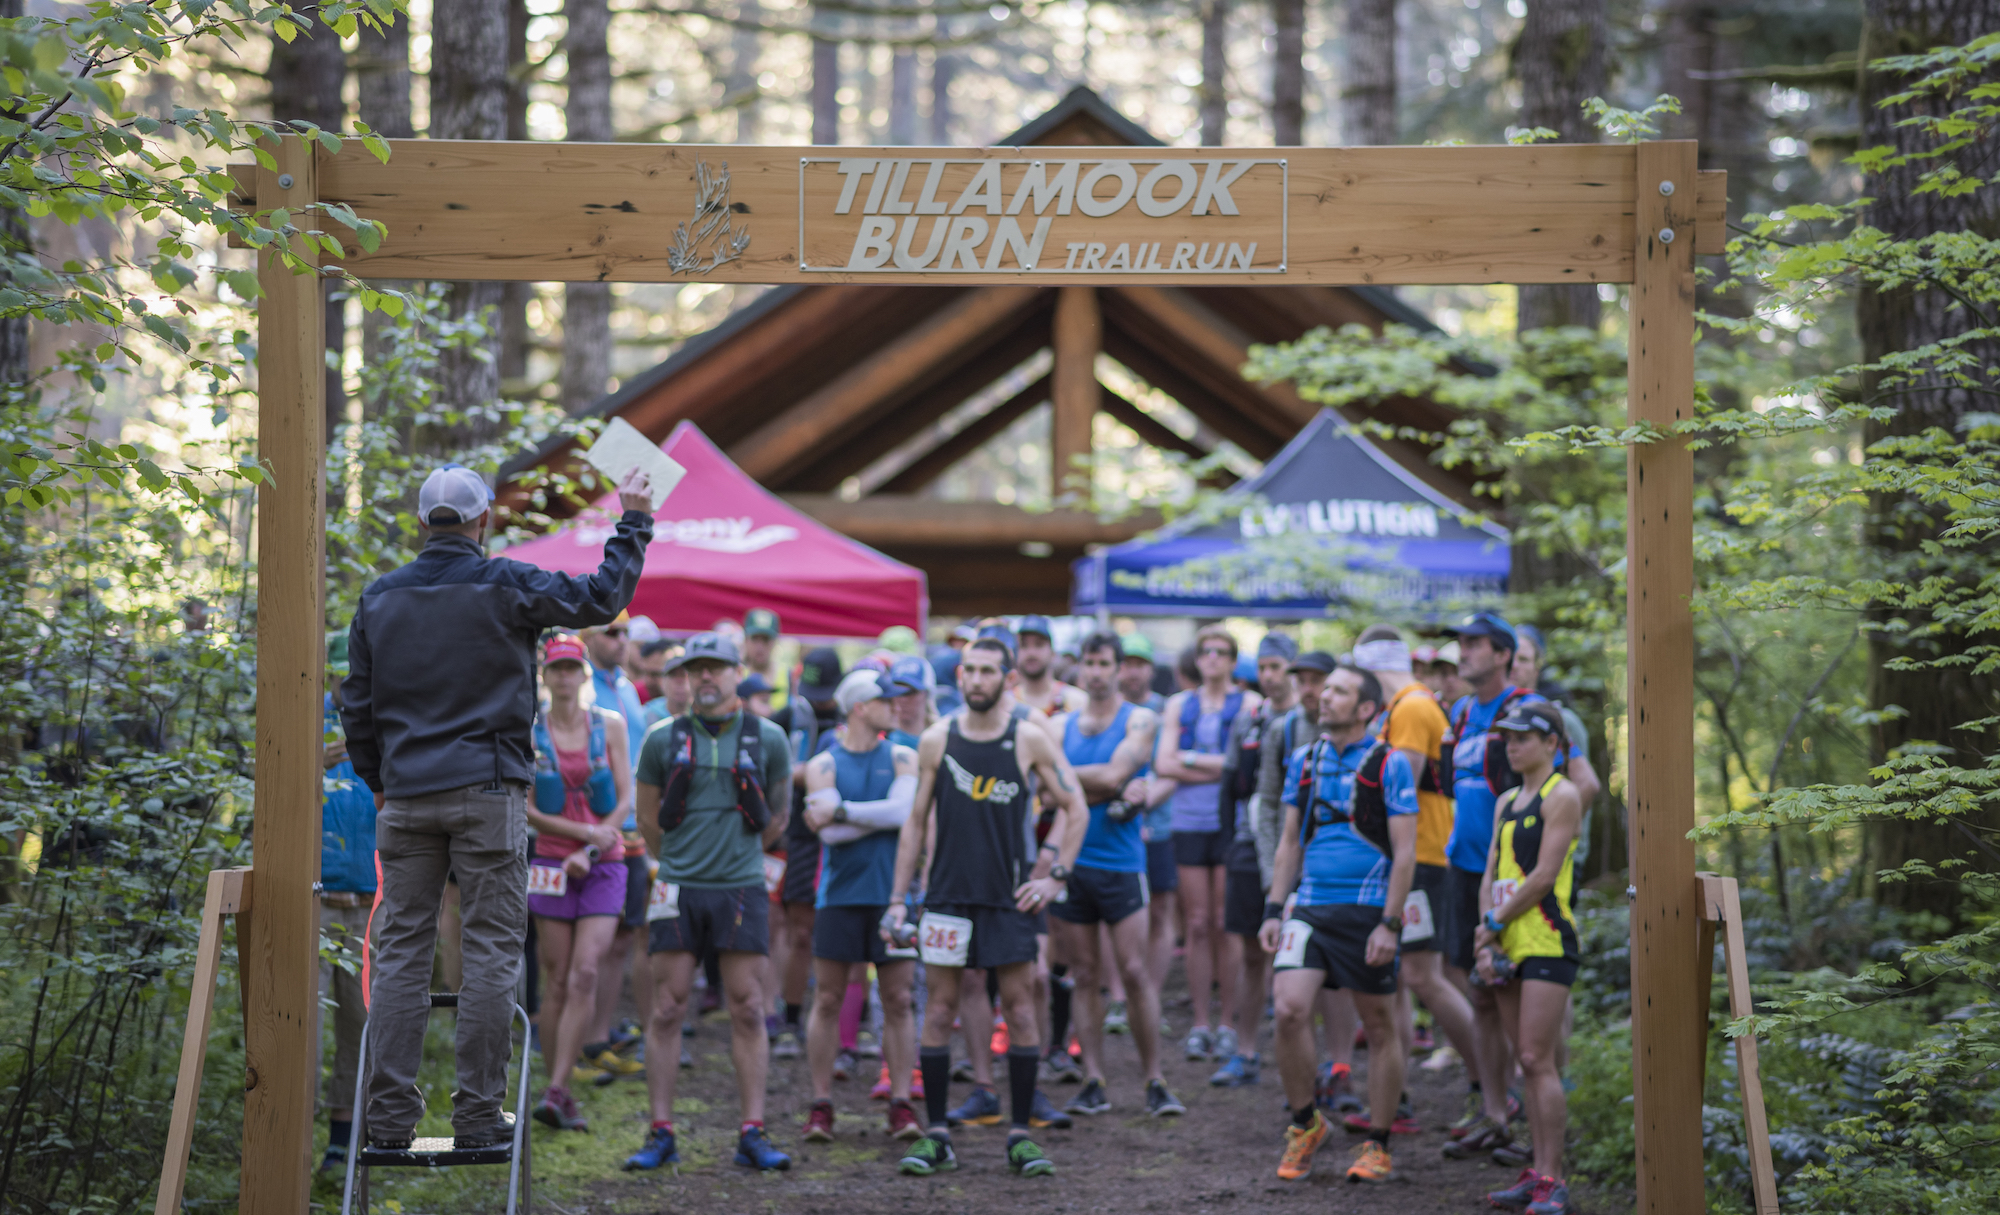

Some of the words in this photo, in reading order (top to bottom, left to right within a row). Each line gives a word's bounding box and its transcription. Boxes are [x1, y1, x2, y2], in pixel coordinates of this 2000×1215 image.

[834, 159, 1258, 218] TILLAMOOK
[847, 216, 1053, 270] BURN
[1064, 242, 1162, 270] TRAIL
[1168, 242, 1258, 270] RUN
